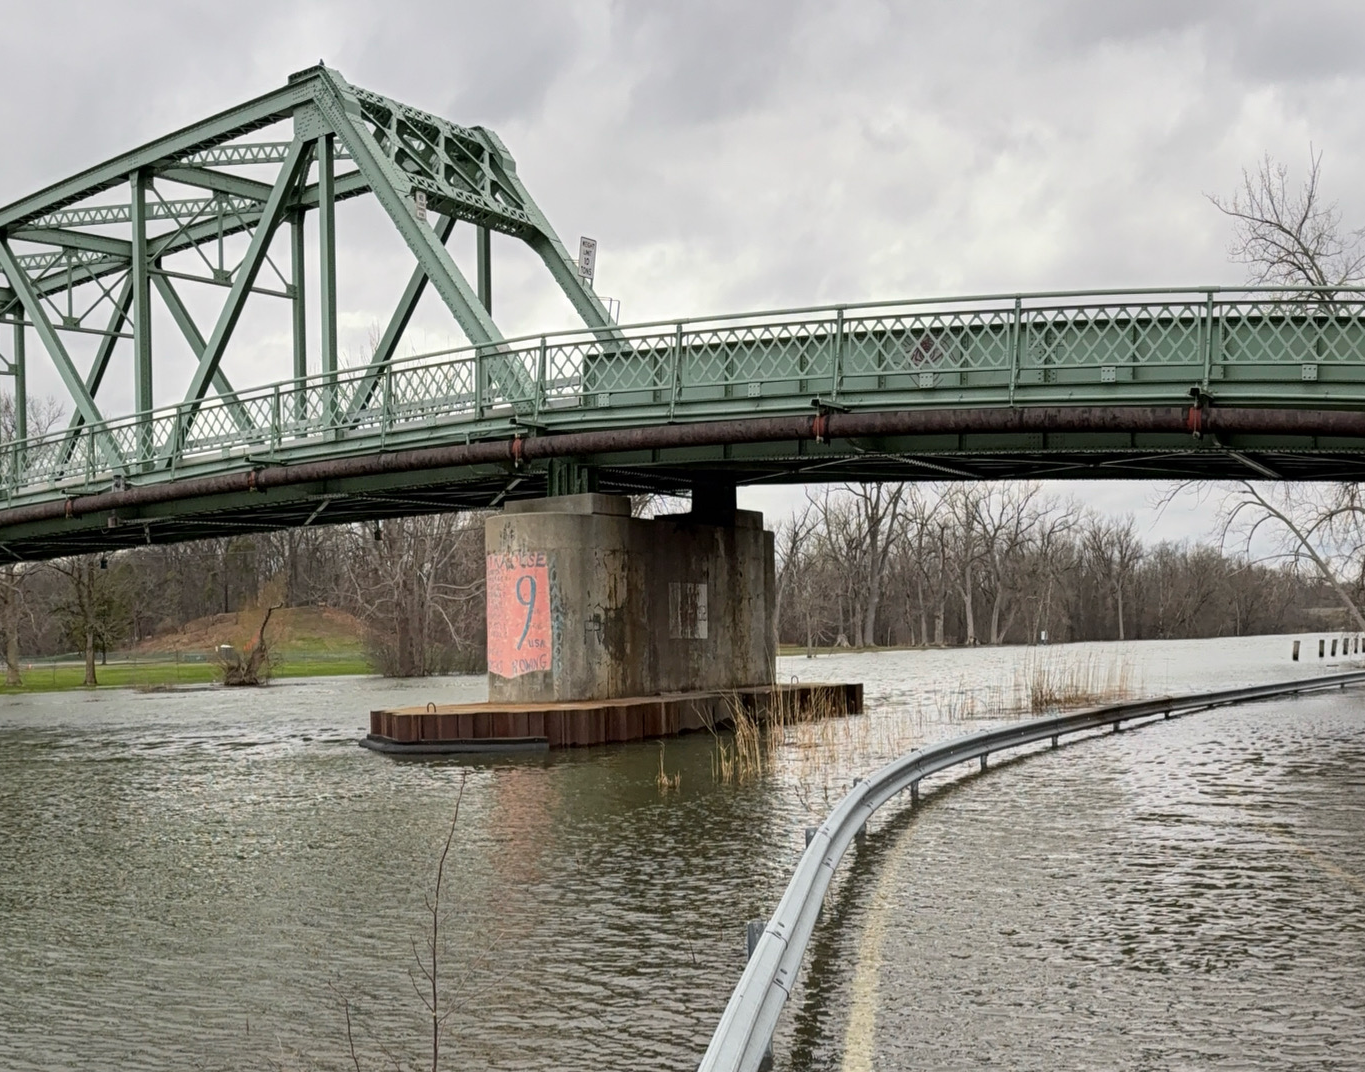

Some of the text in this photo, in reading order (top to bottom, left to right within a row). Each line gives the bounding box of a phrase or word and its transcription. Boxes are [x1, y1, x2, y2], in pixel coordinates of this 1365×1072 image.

[582, 241, 594, 250] WEIGHT
[580, 266, 592, 276] TONS
[516, 575, 536, 651] 9
[528, 638, 546, 649] USA
